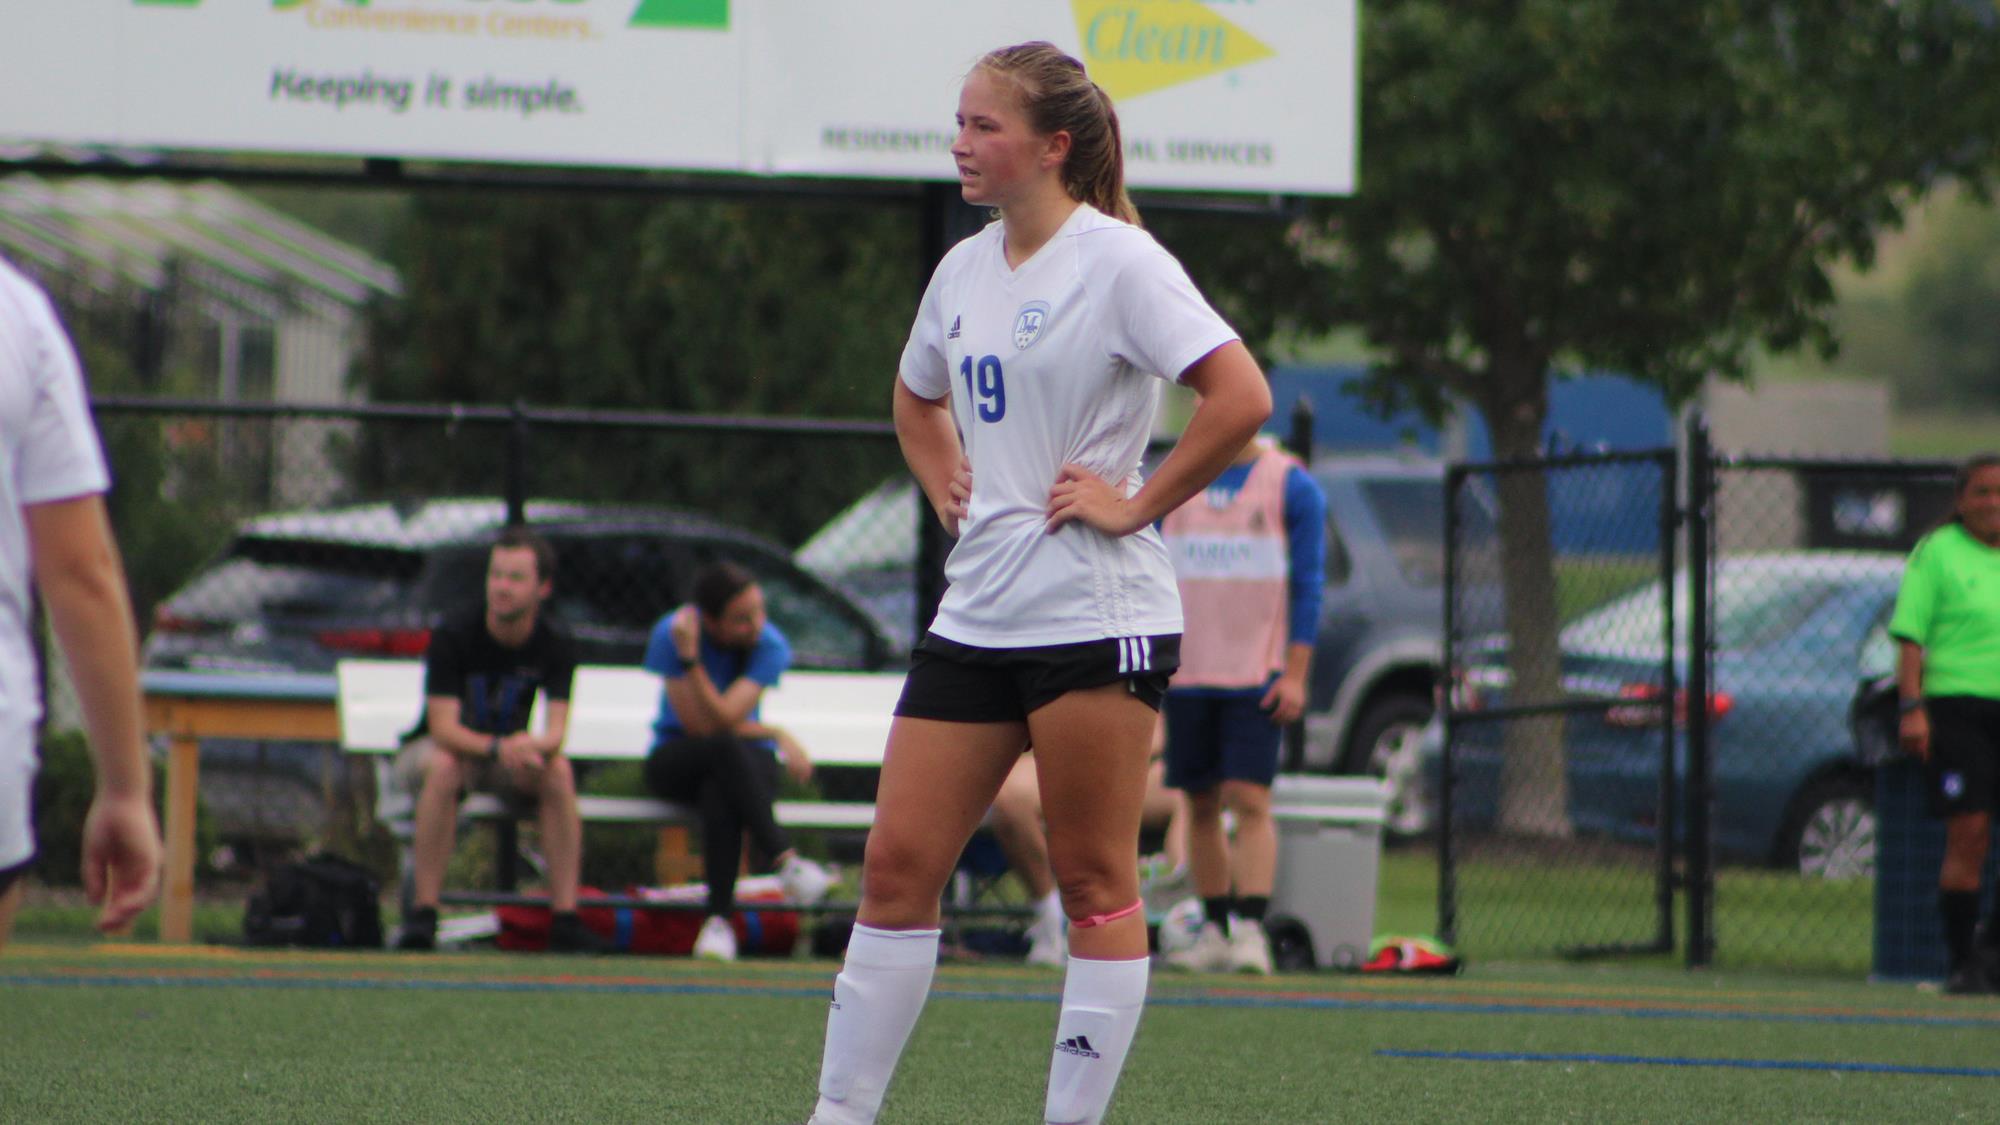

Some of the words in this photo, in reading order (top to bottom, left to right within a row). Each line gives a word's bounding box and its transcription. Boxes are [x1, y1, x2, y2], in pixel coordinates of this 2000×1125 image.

[1087, 8, 1226, 64] Clean
[270, 68, 414, 113] Keeping
[424, 72, 450, 109] it
[464, 74, 586, 115] simple.
[822, 126, 956, 154] RESIDENTIA
[1166, 139, 1273, 166] SERVICES
[960, 354, 1006, 424] 19
